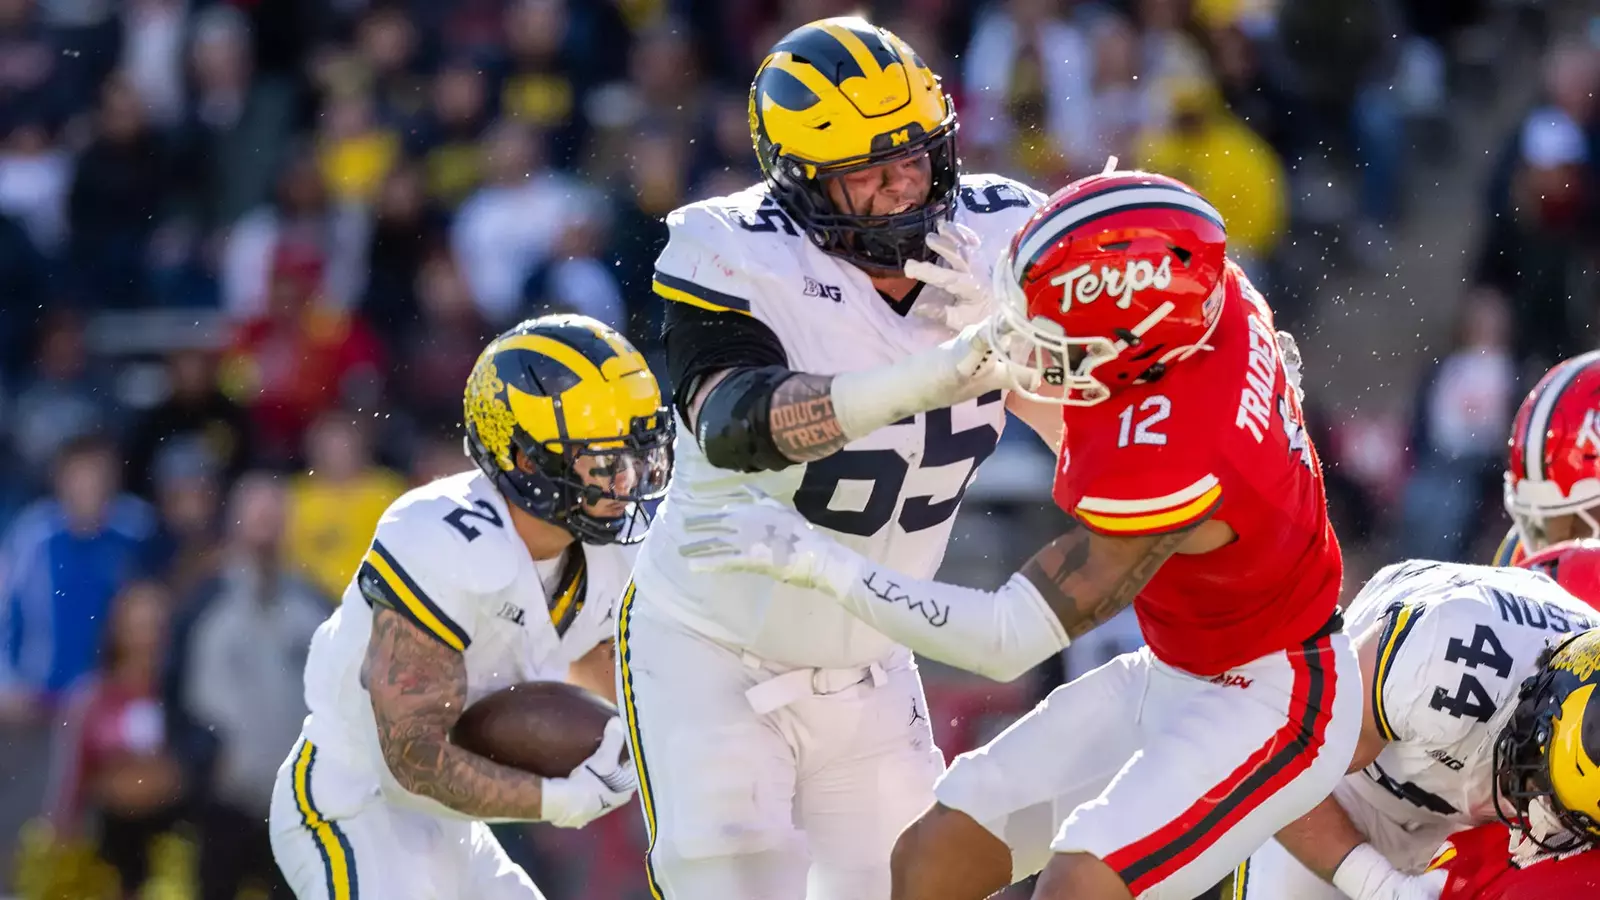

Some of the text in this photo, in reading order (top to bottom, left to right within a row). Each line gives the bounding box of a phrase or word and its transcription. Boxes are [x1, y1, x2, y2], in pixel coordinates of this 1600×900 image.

[891, 129, 910, 147] M
[1051, 256, 1172, 313] Terps
[1118, 395, 1171, 448] 12
[792, 389, 1001, 538] 65
[443, 499, 504, 542] 2
[1428, 624, 1515, 724] 44
